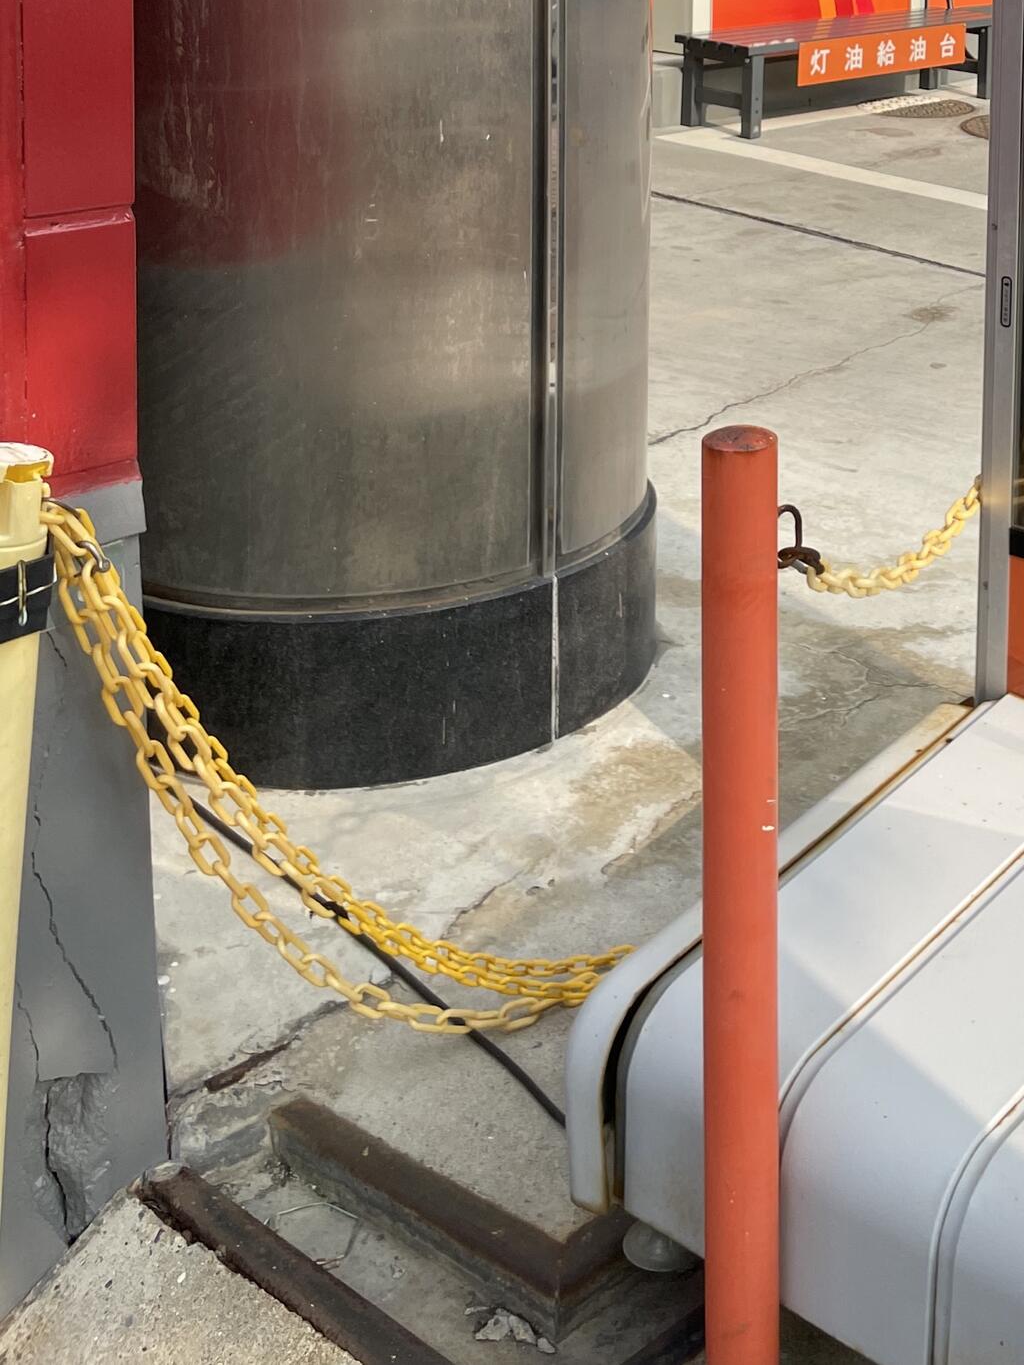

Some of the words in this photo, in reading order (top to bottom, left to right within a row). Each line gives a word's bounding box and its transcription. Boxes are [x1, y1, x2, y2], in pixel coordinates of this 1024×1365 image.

[809, 33, 957, 76] 灯油給油台
